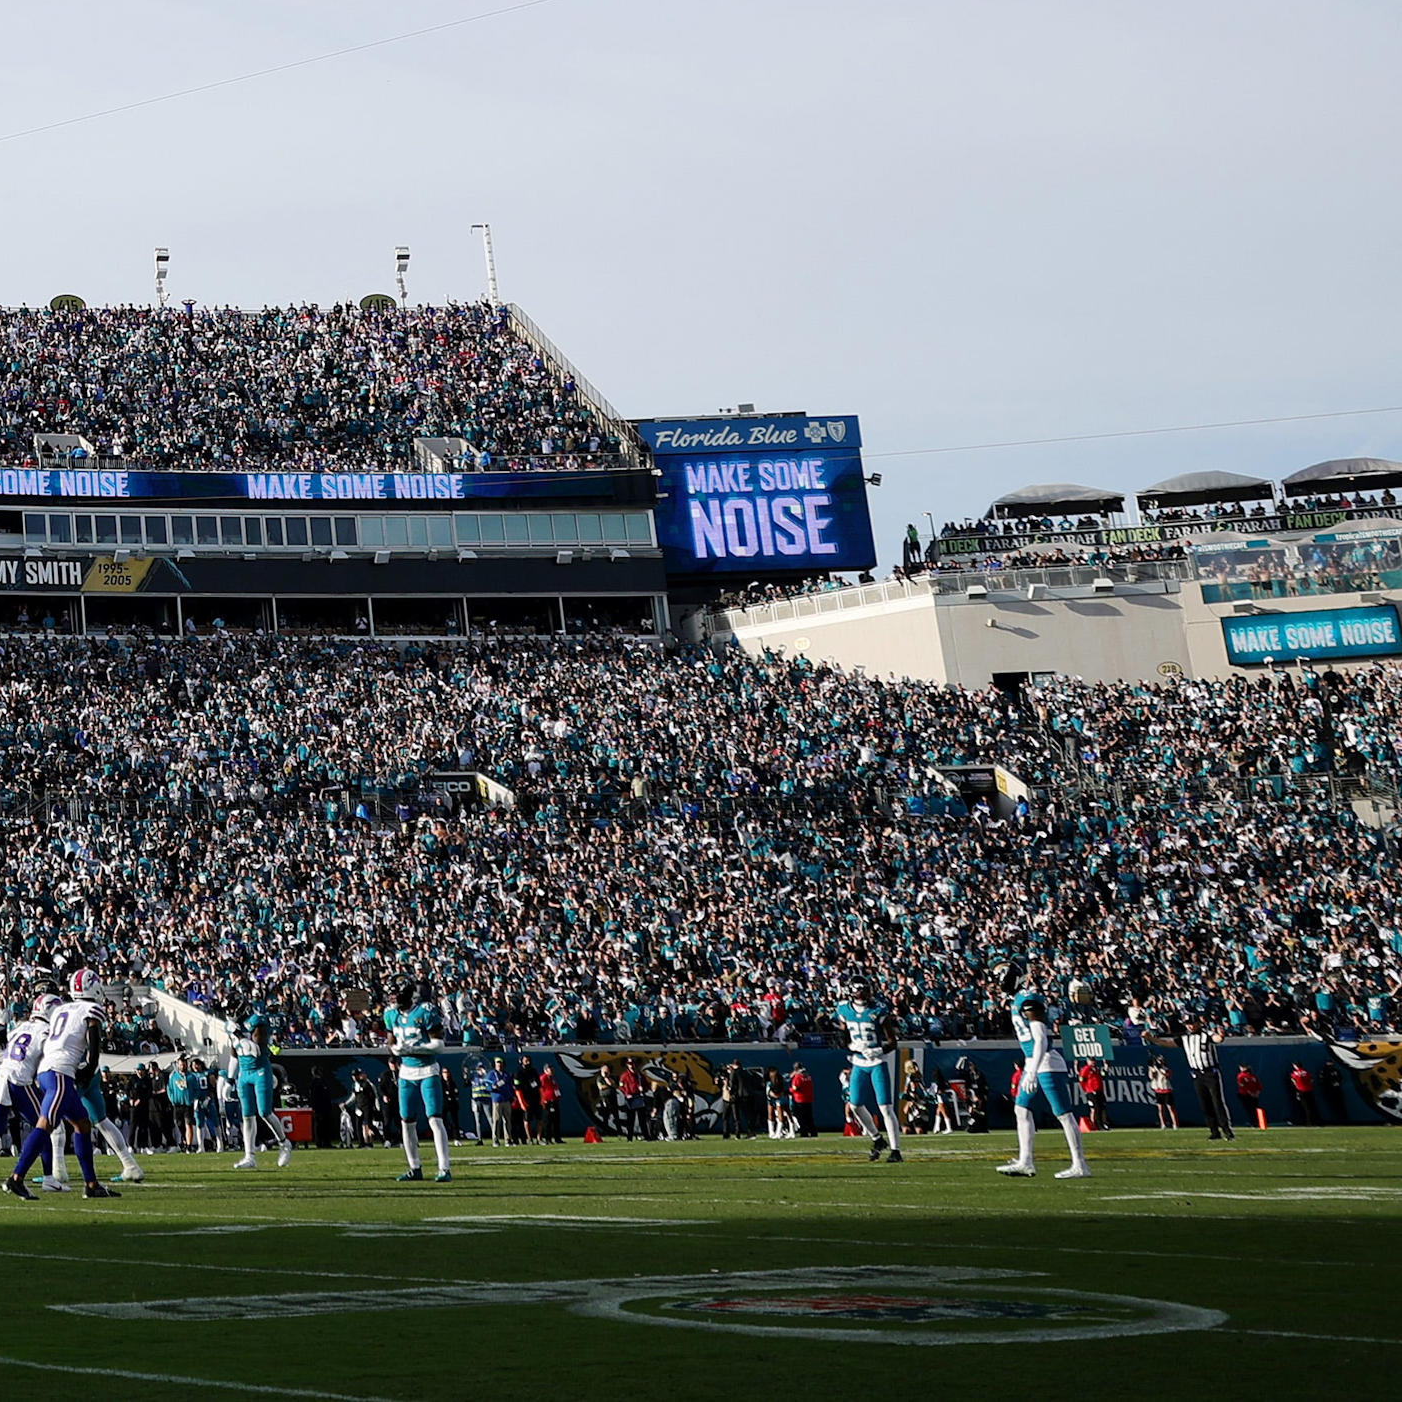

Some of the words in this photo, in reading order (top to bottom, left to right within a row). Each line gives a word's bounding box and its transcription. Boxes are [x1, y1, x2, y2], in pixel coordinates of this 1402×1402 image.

[655, 426, 743, 448] Florida
[747, 424, 798, 445] Blue
[59, 469, 130, 497] NOISE
[247, 472, 313, 499] MAKE
[320, 473, 389, 499] SOME
[394, 473, 465, 499] NOISE
[686, 460, 754, 494] MAKE
[758, 458, 827, 491] SOME
[689, 494, 839, 559] NOISE
[949, 538, 980, 553] DECK
[984, 534, 1029, 550] FARAH
[1050, 530, 1096, 545] FARAH
[1101, 529, 1128, 544] FAN
[1129, 527, 1162, 542] DECK
[1164, 523, 1212, 539] FARAH
[1233, 518, 1282, 533] FARAH
[1286, 514, 1313, 529] FAN
[1315, 511, 1347, 528] DECK
[25, 560, 83, 586] SMITH
[98, 563, 129, 574] 1995-
[103, 574, 132, 586] 2005
[1230, 625, 1282, 654] MAKE
[1283, 621, 1337, 650] SOME
[1339, 617, 1396, 646] NOISE
[1073, 1027, 1096, 1042] GET
[1072, 1042, 1104, 1058] LOUD
